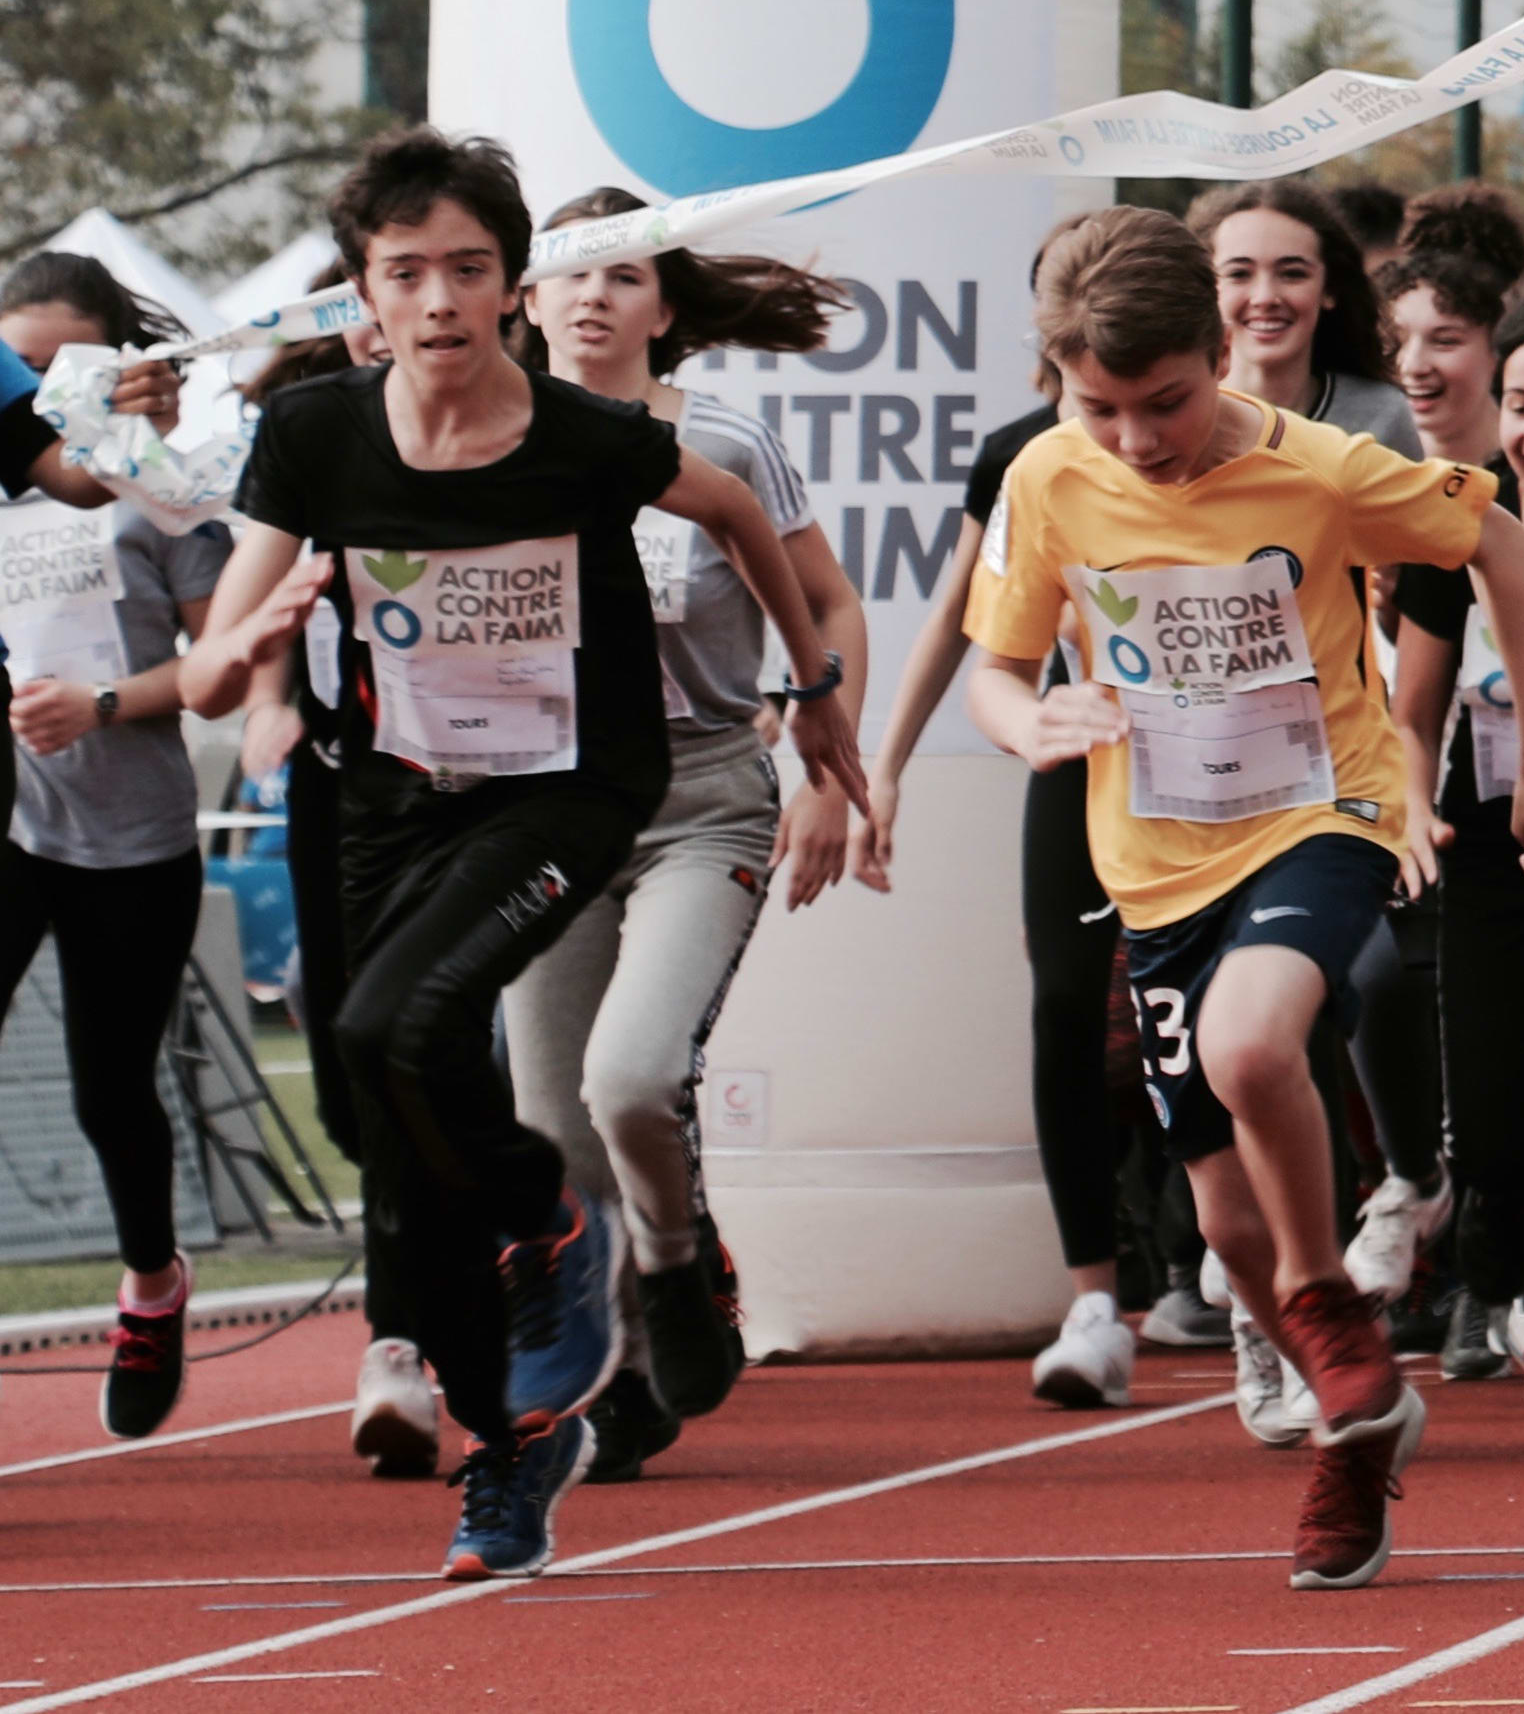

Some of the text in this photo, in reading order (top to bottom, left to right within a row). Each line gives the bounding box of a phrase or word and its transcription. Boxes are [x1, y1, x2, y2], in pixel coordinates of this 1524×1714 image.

[2, 521, 99, 554] ACTION
[3, 545, 104, 579] CONTRE
[438, 560, 562, 592] ACTION
[5, 569, 108, 605] LA FAIM
[436, 586, 562, 618] CONTRE
[1154, 589, 1280, 624] ACTION
[435, 613, 565, 645] LA FAIM
[1157, 614, 1286, 651] CONTRE
[1209, 640, 1293, 678] FAIM
[448, 718, 489, 729] TOURS
[1202, 760, 1241, 774] TOURS
